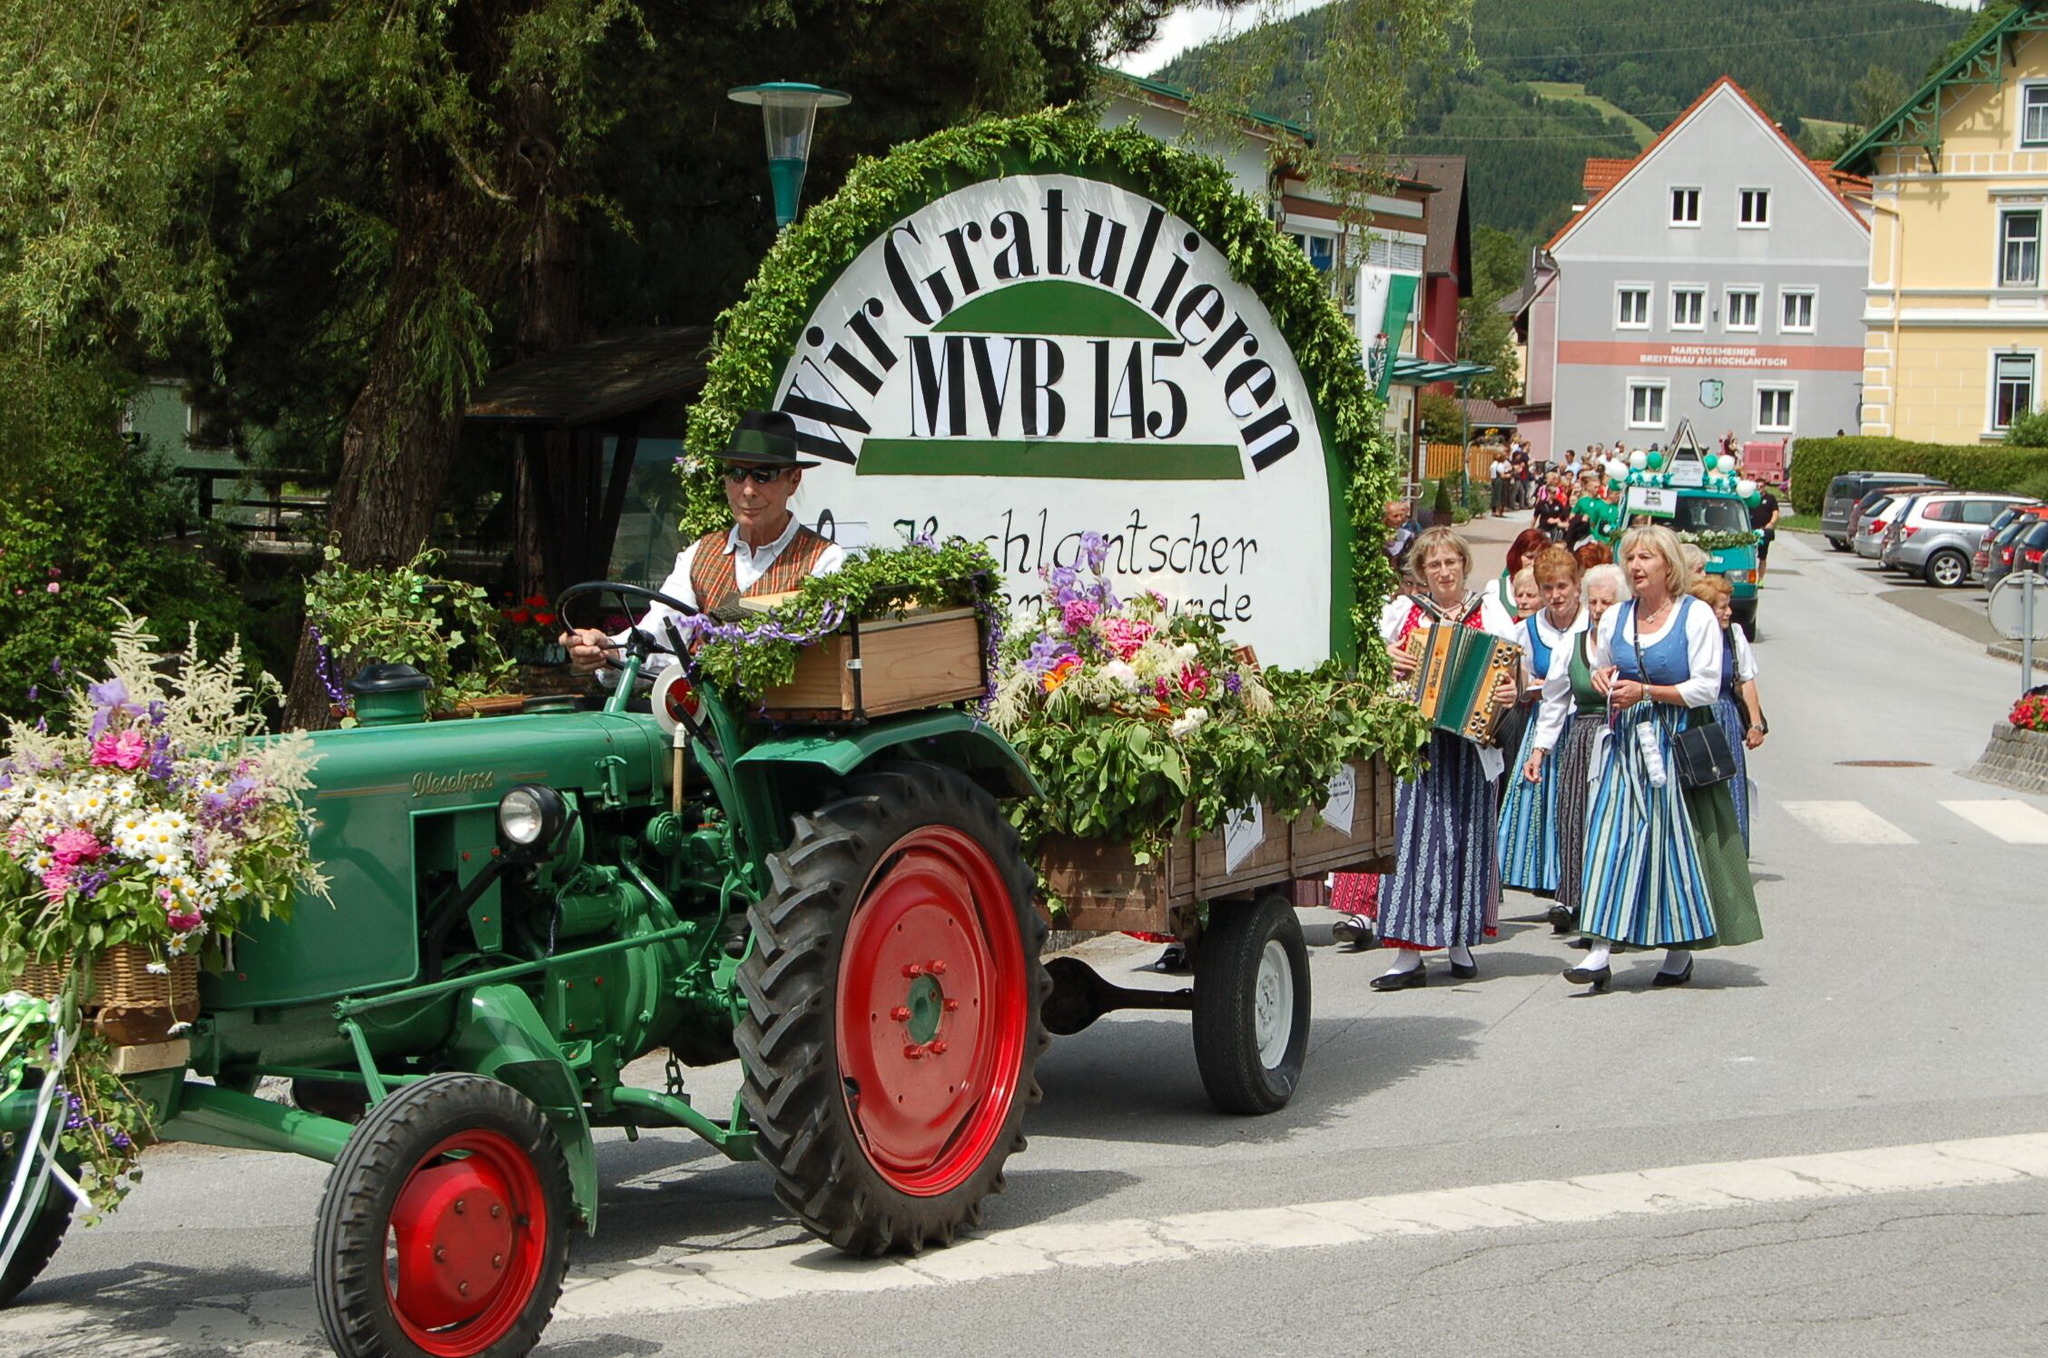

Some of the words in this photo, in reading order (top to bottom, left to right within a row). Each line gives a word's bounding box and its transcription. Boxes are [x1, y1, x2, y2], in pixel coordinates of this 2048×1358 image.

[779, 297, 898, 466] Wir
[884, 189, 1300, 472] Gratulieren
[1671, 346, 1757, 356] MARKTGEMEINDE
[905, 336, 1066, 438] MVB
[1087, 340, 1187, 440] 145
[1640, 354, 1695, 365] BREITENAU
[1696, 356, 1712, 365] AM
[1714, 356, 1788, 367] HOCHLANTSCH
